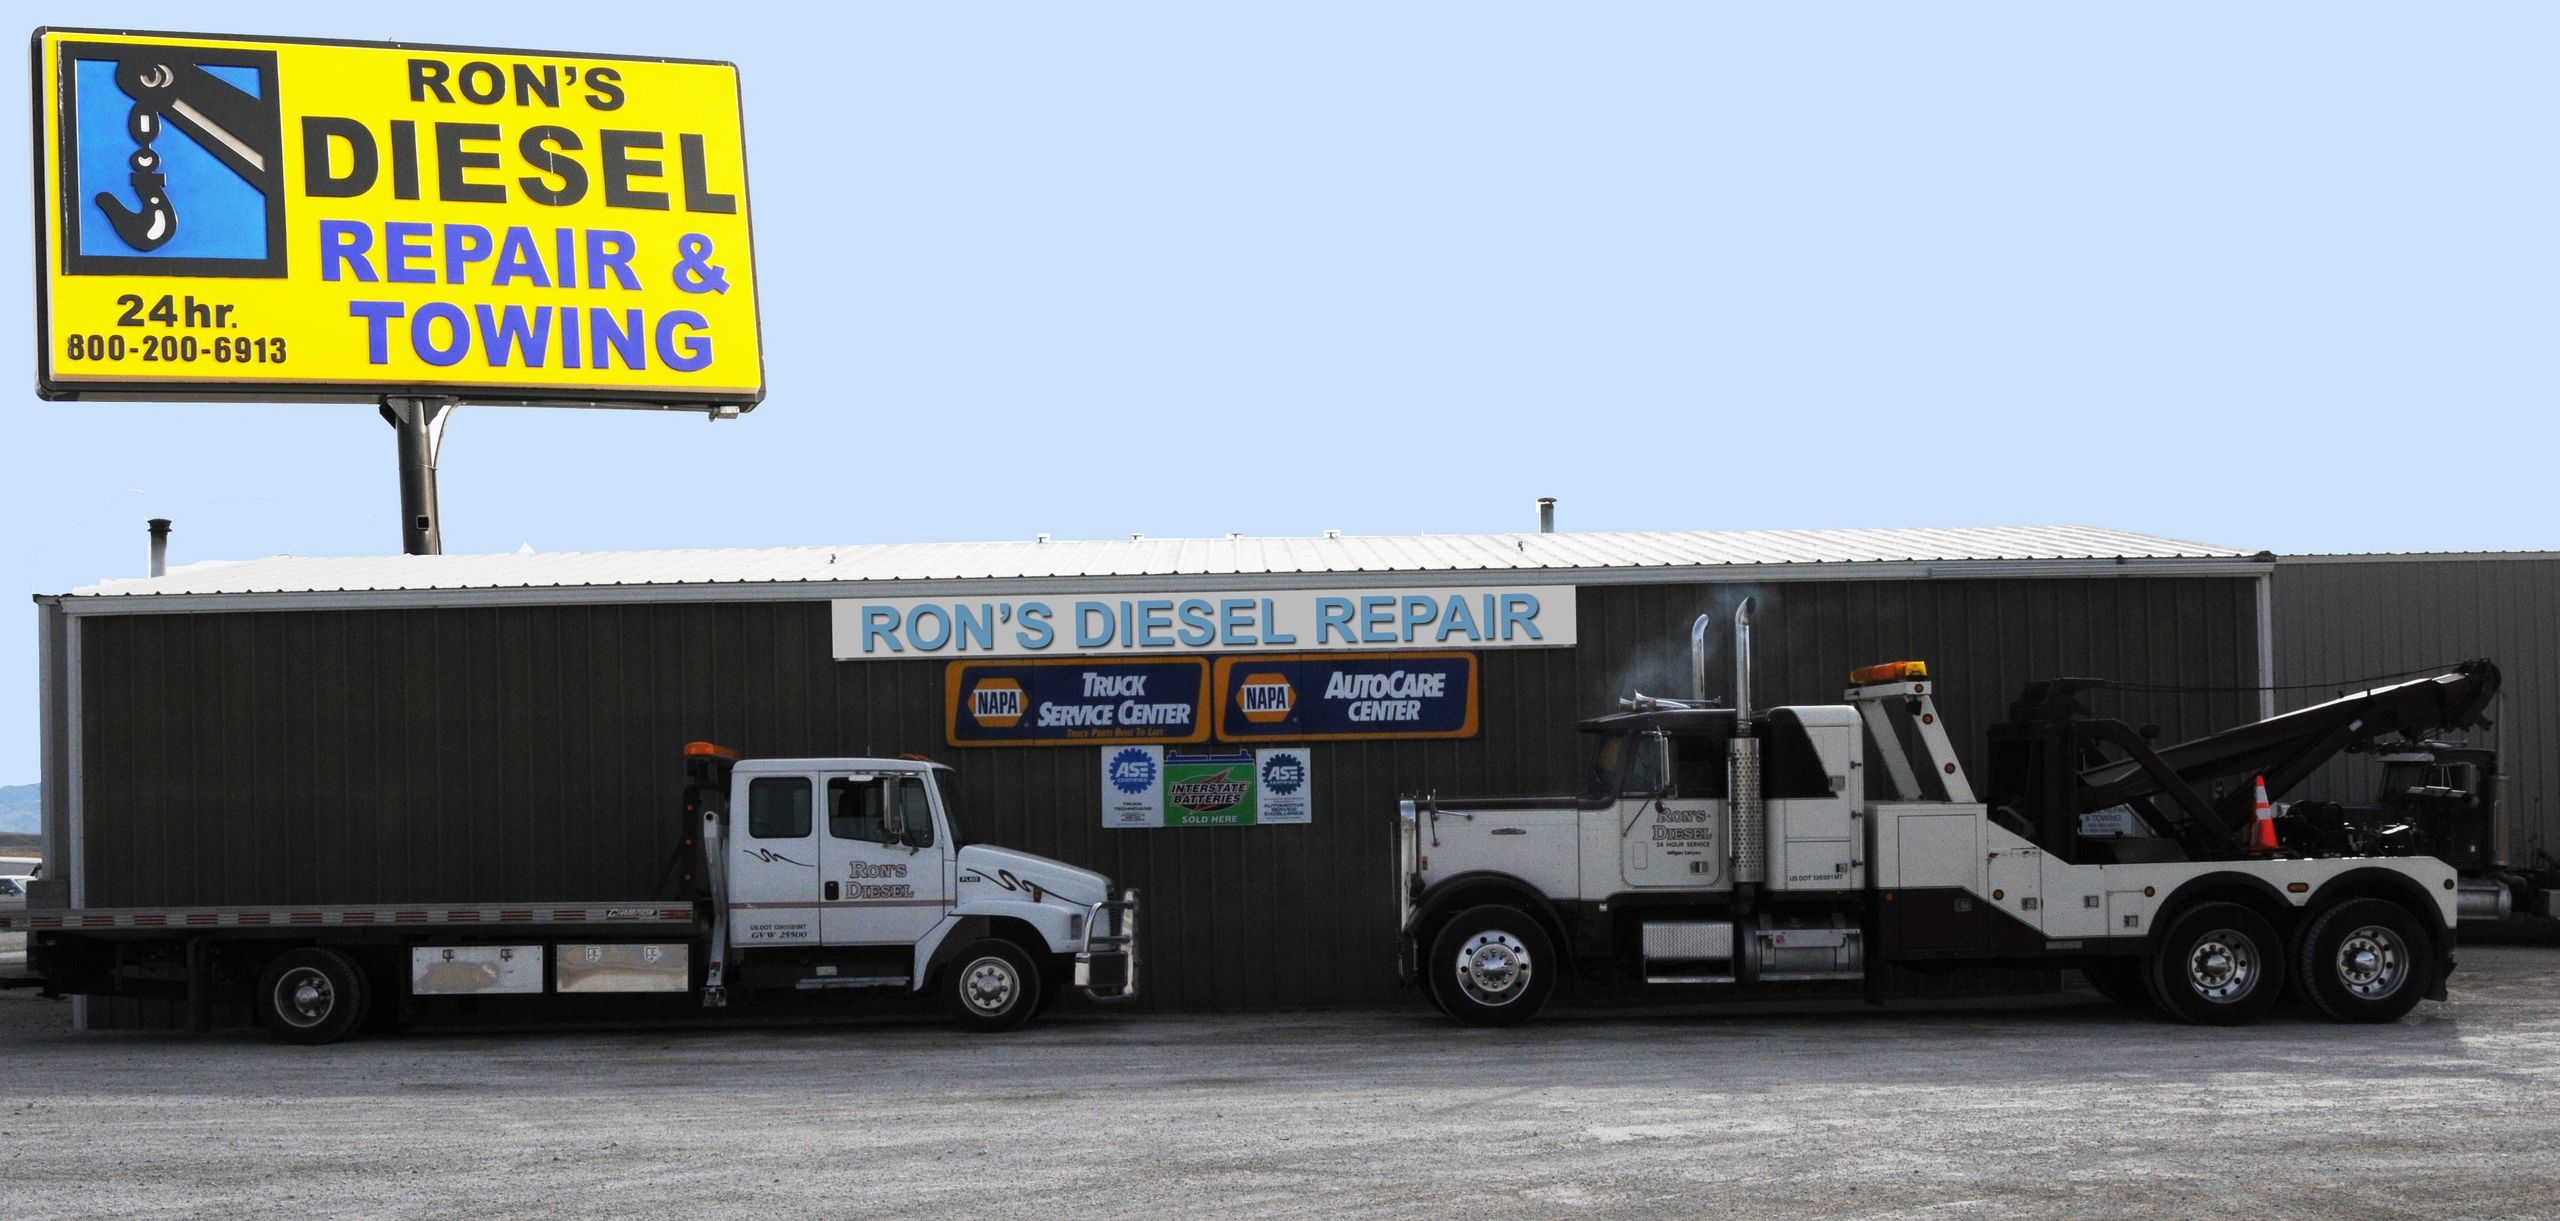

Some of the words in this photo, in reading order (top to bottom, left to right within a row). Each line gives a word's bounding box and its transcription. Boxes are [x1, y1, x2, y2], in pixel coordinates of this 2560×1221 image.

[407, 58, 625, 112] RON'S
[301, 115, 737, 215] DIESEL
[320, 219, 642, 291] REPAIR
[673, 233, 730, 295] &
[116, 293, 239, 330] 24hr.
[349, 300, 714, 373] TOWING
[66, 333, 288, 365] 800-200-6913
[861, 601, 1055, 653] RON'S
[1075, 599, 1296, 648] DIESEL
[1315, 593, 1544, 645] REPAIR
[1082, 672, 1148, 698] TRUCK
[976, 691, 1022, 715] NAPA
[1244, 686, 1288, 711] NAPA
[1037, 700, 1113, 727] SERVICE
[1117, 699, 1192, 726] CENTER
[1348, 700, 1422, 722] CENTER
[1115, 762, 1149, 778] ASE
[1267, 766, 1298, 780] ASE
[1171, 783, 1248, 793] INTERSTATE
[1173, 794, 1241, 804] BATTERIES
[1182, 816, 1208, 824] SOLD
[1211, 815, 1238, 823] HERE
[1656, 807, 1706, 823] RON'S
[1652, 825, 1712, 840] DIESEL
[849, 861, 907, 879] RON'S
[845, 881, 915, 900] DIESEL
